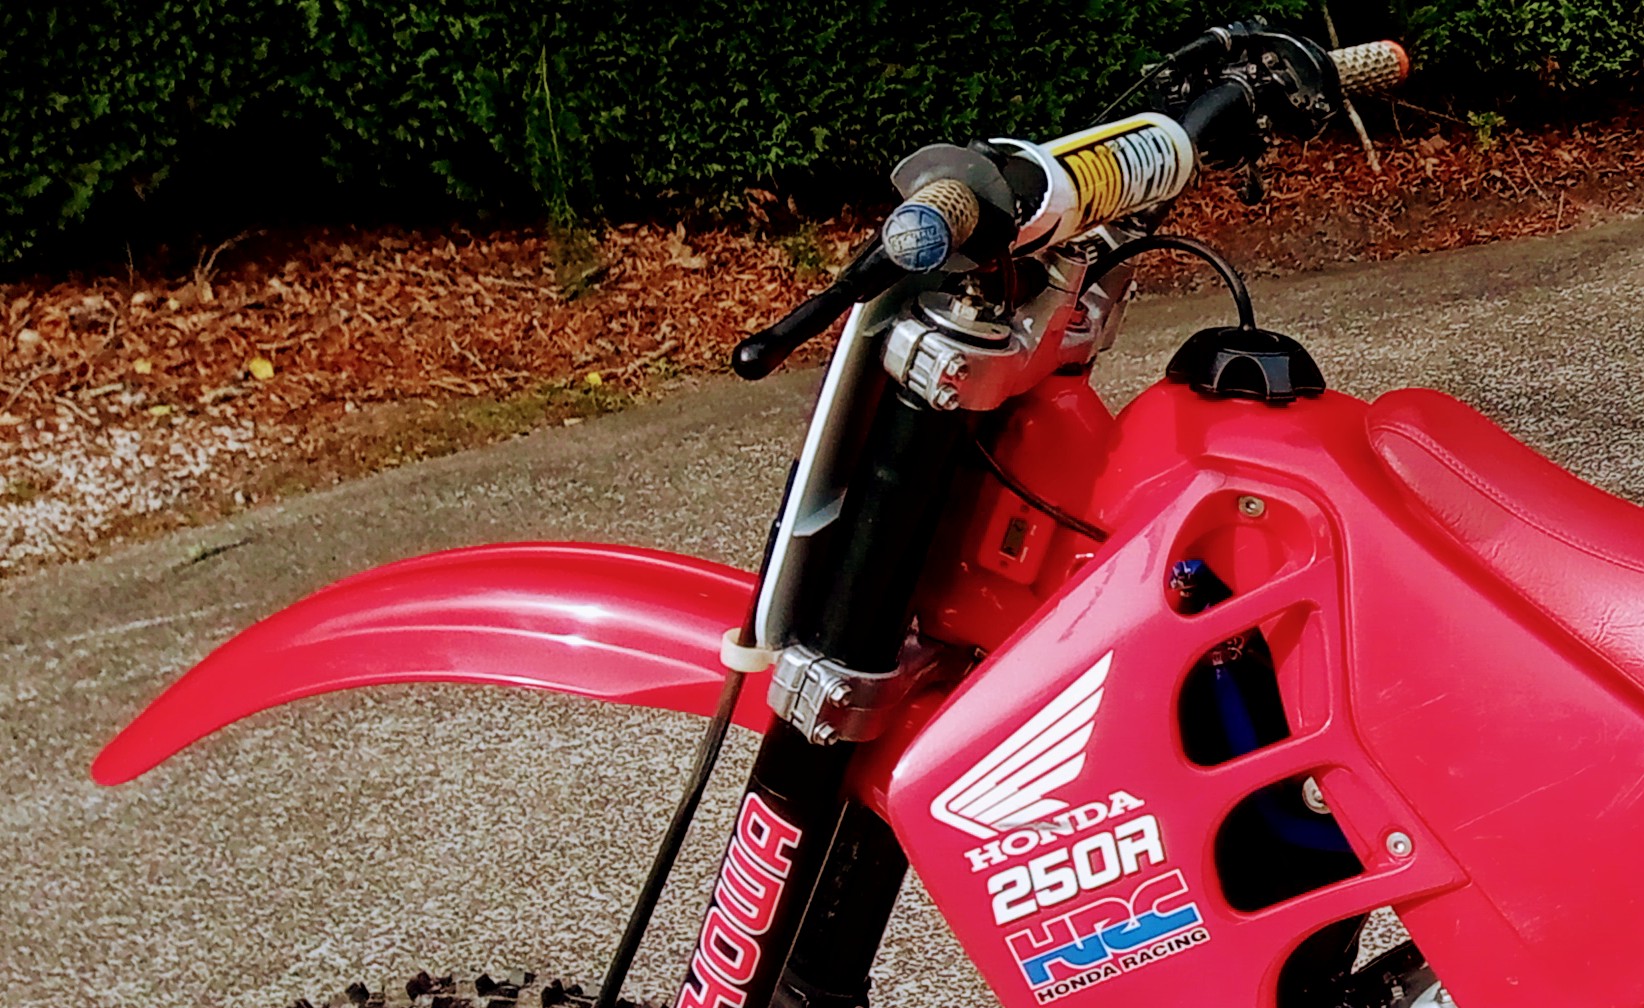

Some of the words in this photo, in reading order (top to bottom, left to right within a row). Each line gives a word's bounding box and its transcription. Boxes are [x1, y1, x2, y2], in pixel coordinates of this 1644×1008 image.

[964, 790, 1145, 873] HONDA
[987, 814, 1165, 926] 250R
[1005, 868, 1203, 987] HRC
[1037, 963, 1118, 1005] HONDA
[1123, 928, 1212, 971] RACING
